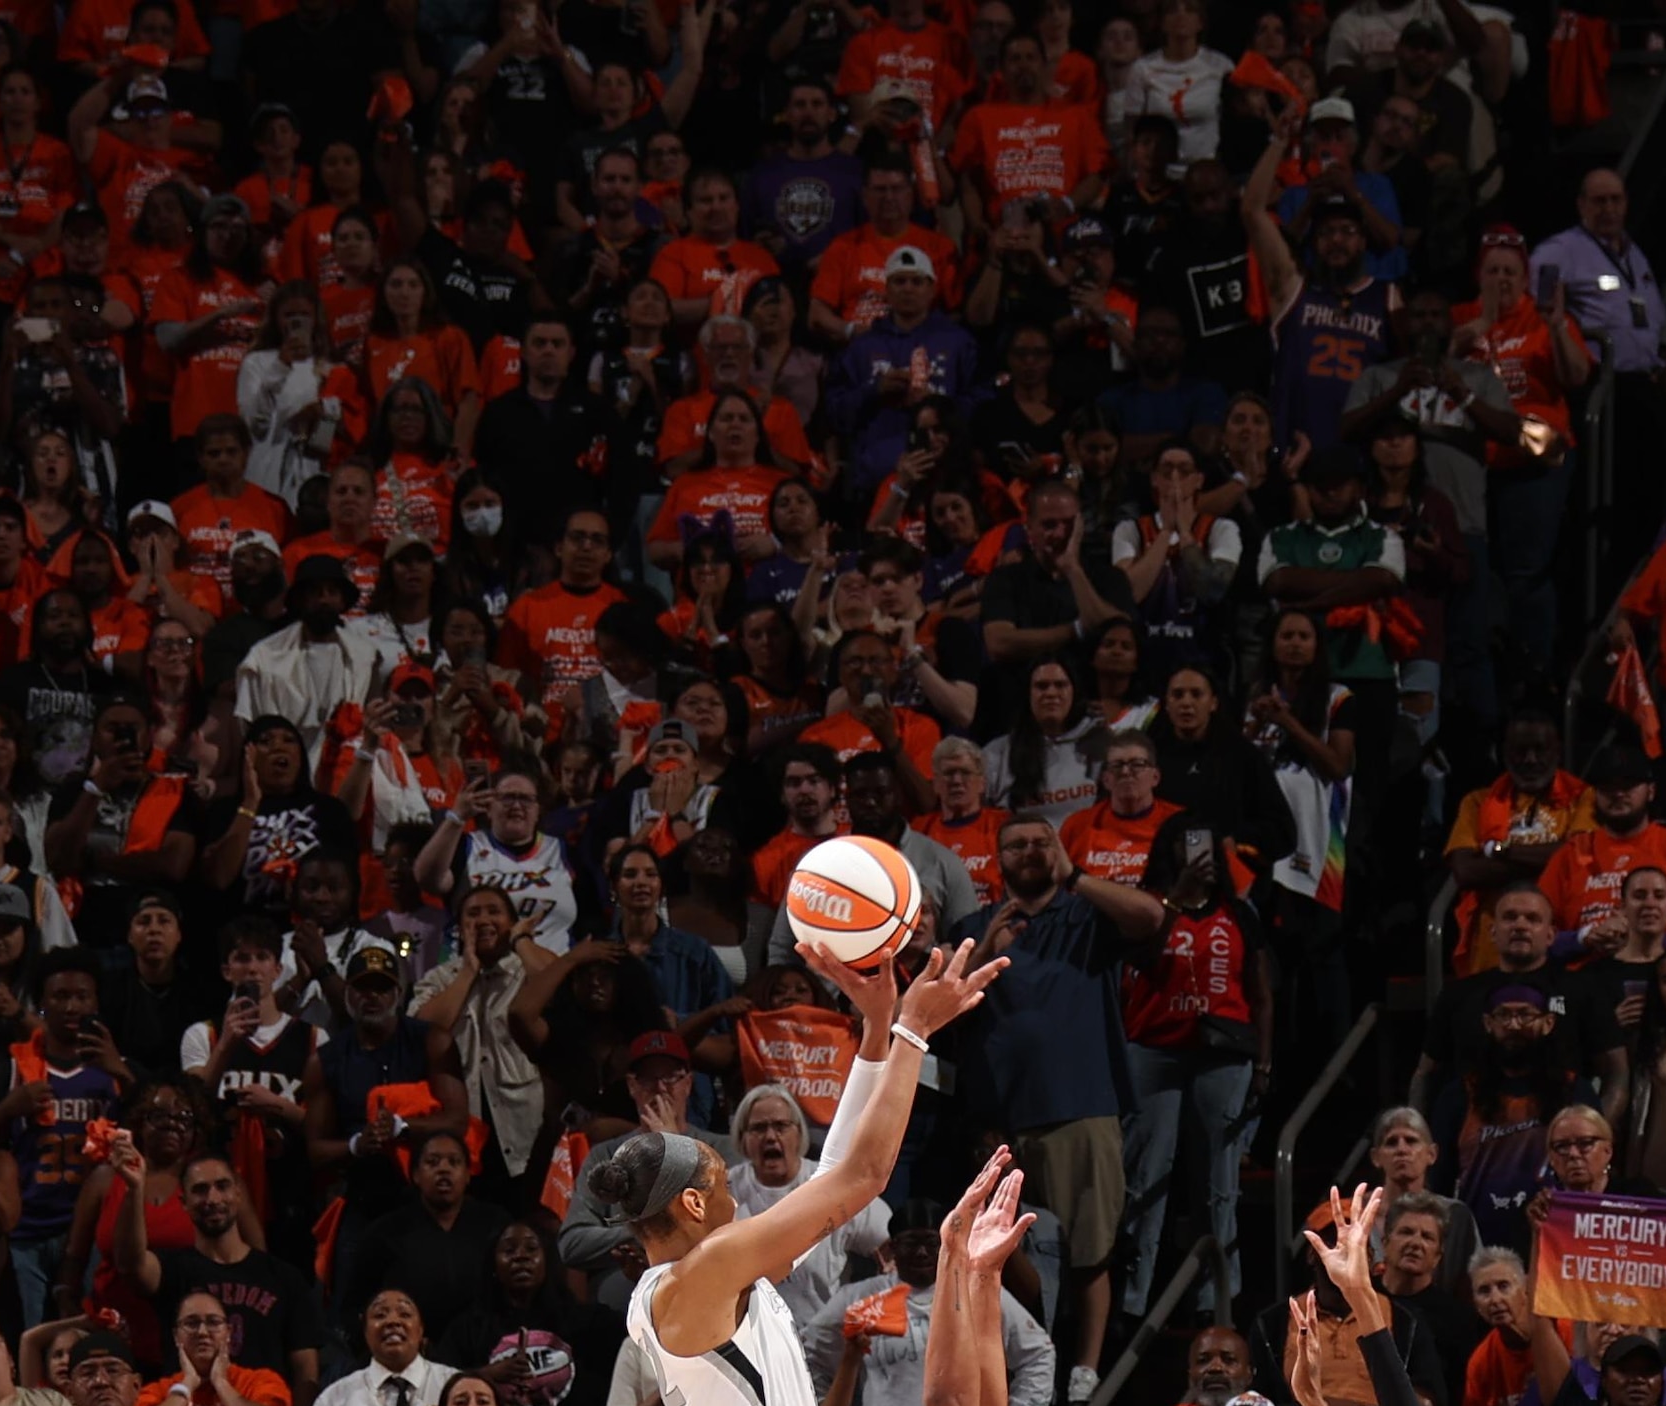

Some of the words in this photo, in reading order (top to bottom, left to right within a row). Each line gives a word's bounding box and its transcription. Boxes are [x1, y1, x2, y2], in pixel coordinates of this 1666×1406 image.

[1306, 333, 1368, 382] 25
[786, 876, 853, 924] Wilson
[1168, 991, 1210, 1016] ring
[758, 1038, 841, 1067] MERCURY
